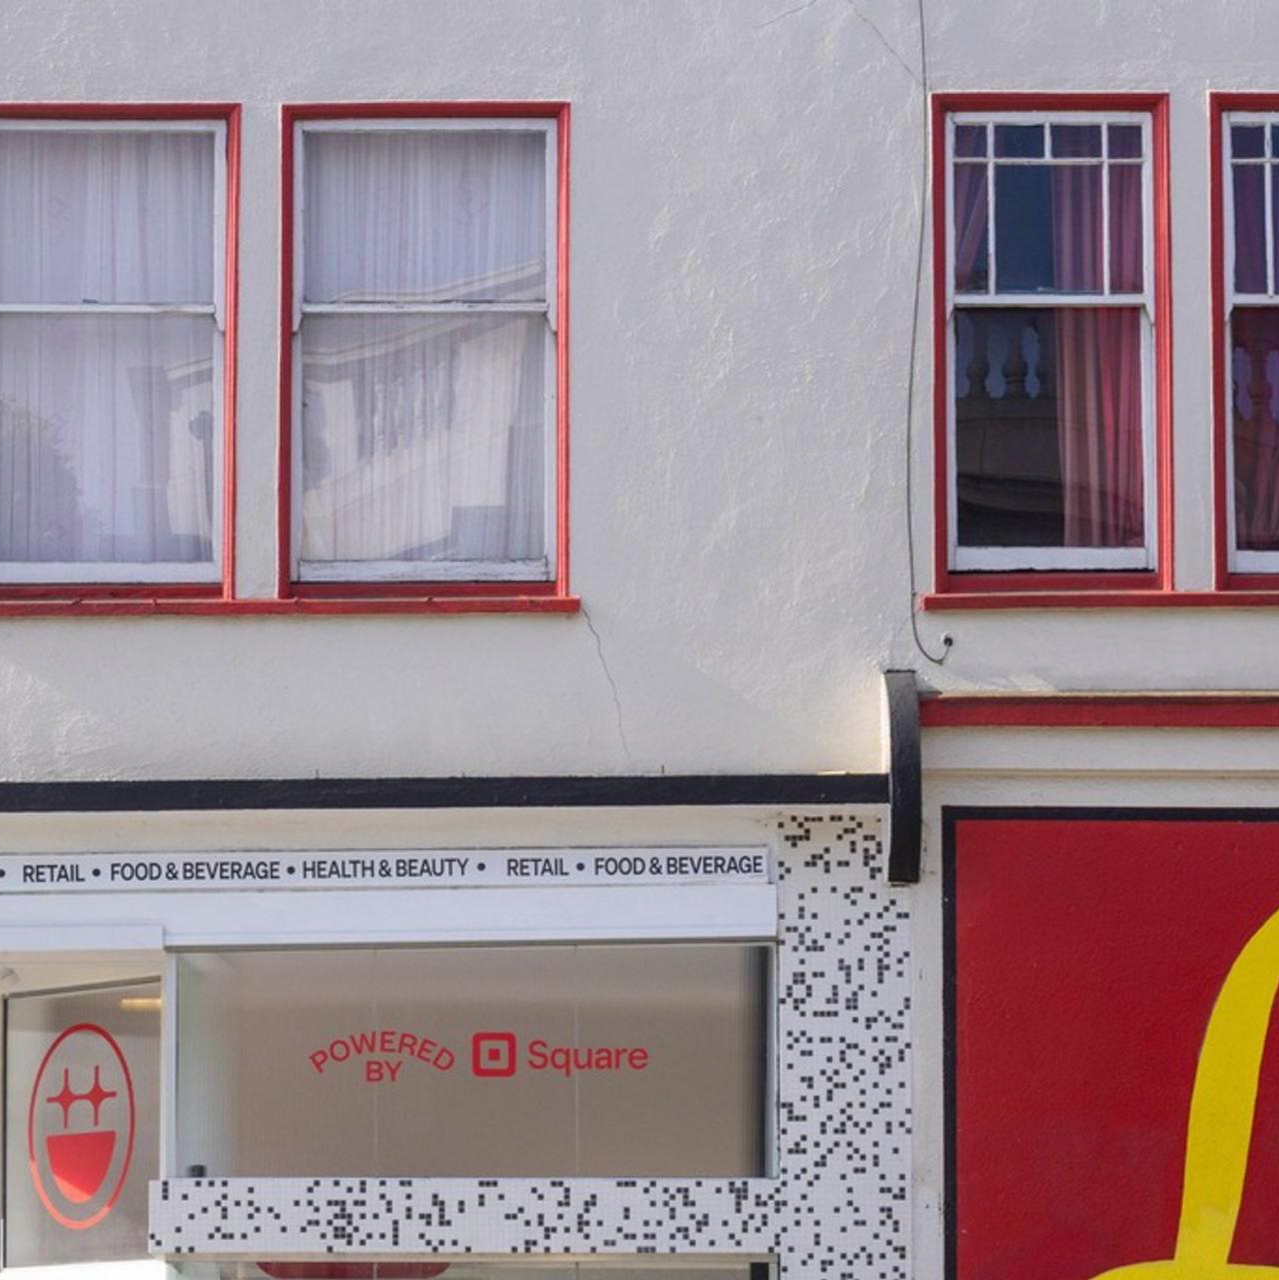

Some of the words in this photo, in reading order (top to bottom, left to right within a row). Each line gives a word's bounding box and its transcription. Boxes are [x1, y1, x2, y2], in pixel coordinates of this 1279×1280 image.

[23, 864, 85, 882] RETAIL
[110, 863, 162, 881] FOOD
[183, 861, 280, 880] BEVERAGE
[303, 860, 375, 879] HEALTH
[396, 858, 469, 878] BEAUTY
[507, 858, 570, 876] RETAIL
[594, 857, 645, 875] FOOD
[666, 855, 764, 875] BEVERAGE
[309, 1031, 455, 1073] POWERED
[528, 1040, 649, 1077] Square
[366, 1060, 403, 1082] BY
